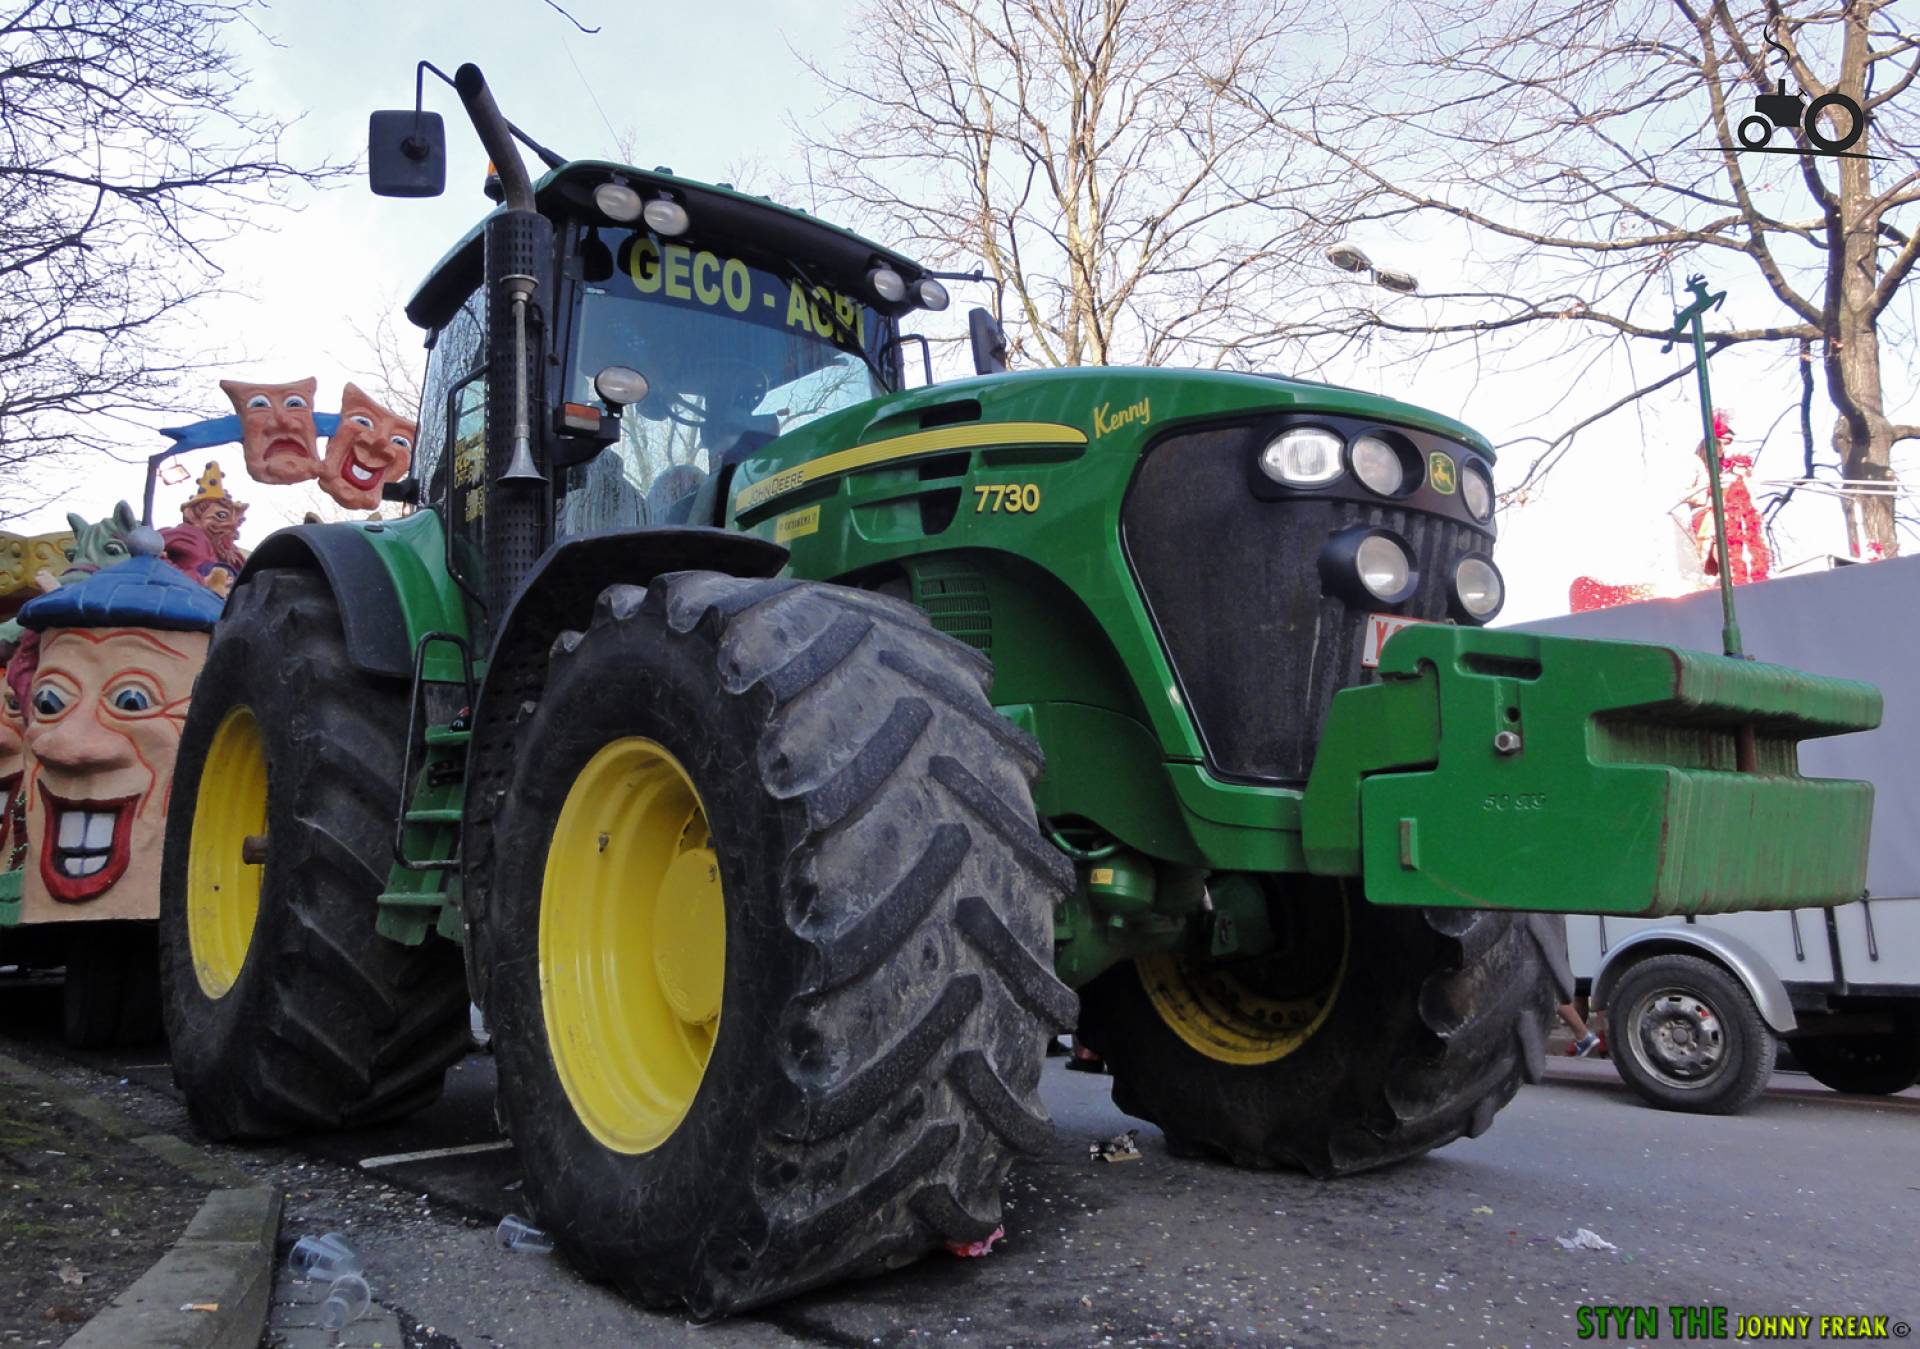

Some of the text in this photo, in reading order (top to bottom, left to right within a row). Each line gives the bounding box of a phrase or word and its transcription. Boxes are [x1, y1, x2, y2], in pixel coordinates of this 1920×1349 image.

[630, 238, 750, 312] GECO
[1093, 397, 1150, 439] Kenny
[772, 470, 805, 496] DEERE
[974, 483, 1040, 514] 7730
